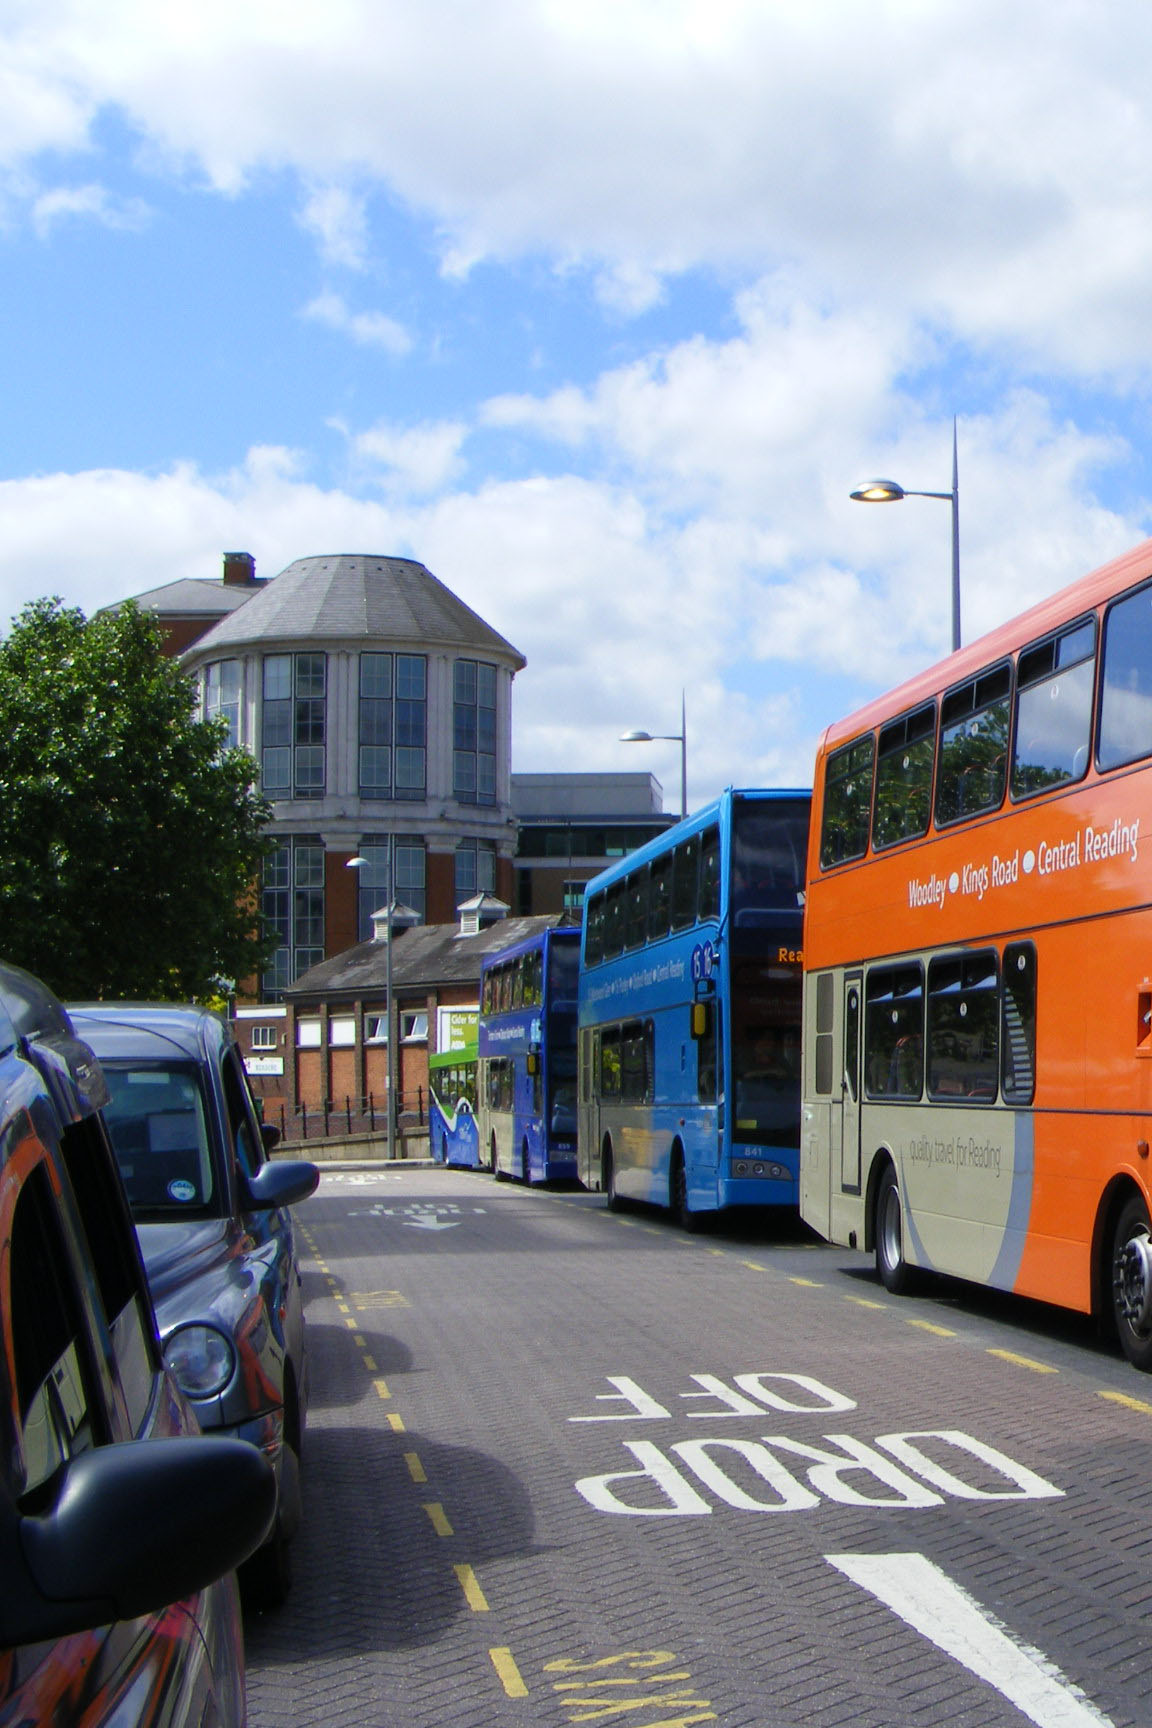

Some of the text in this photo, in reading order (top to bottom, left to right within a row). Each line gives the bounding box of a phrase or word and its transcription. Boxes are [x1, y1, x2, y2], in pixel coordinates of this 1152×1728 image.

[908, 873, 947, 909] Woodley
[991, 849, 1019, 887] Road
[1037, 831, 1081, 875] Central
[1084, 818, 1140, 862] Reading
[909, 1135, 1002, 1178] quality travel for Reading
[567, 1373, 857, 1421] OFF
[575, 1430, 1067, 1515] DROP
